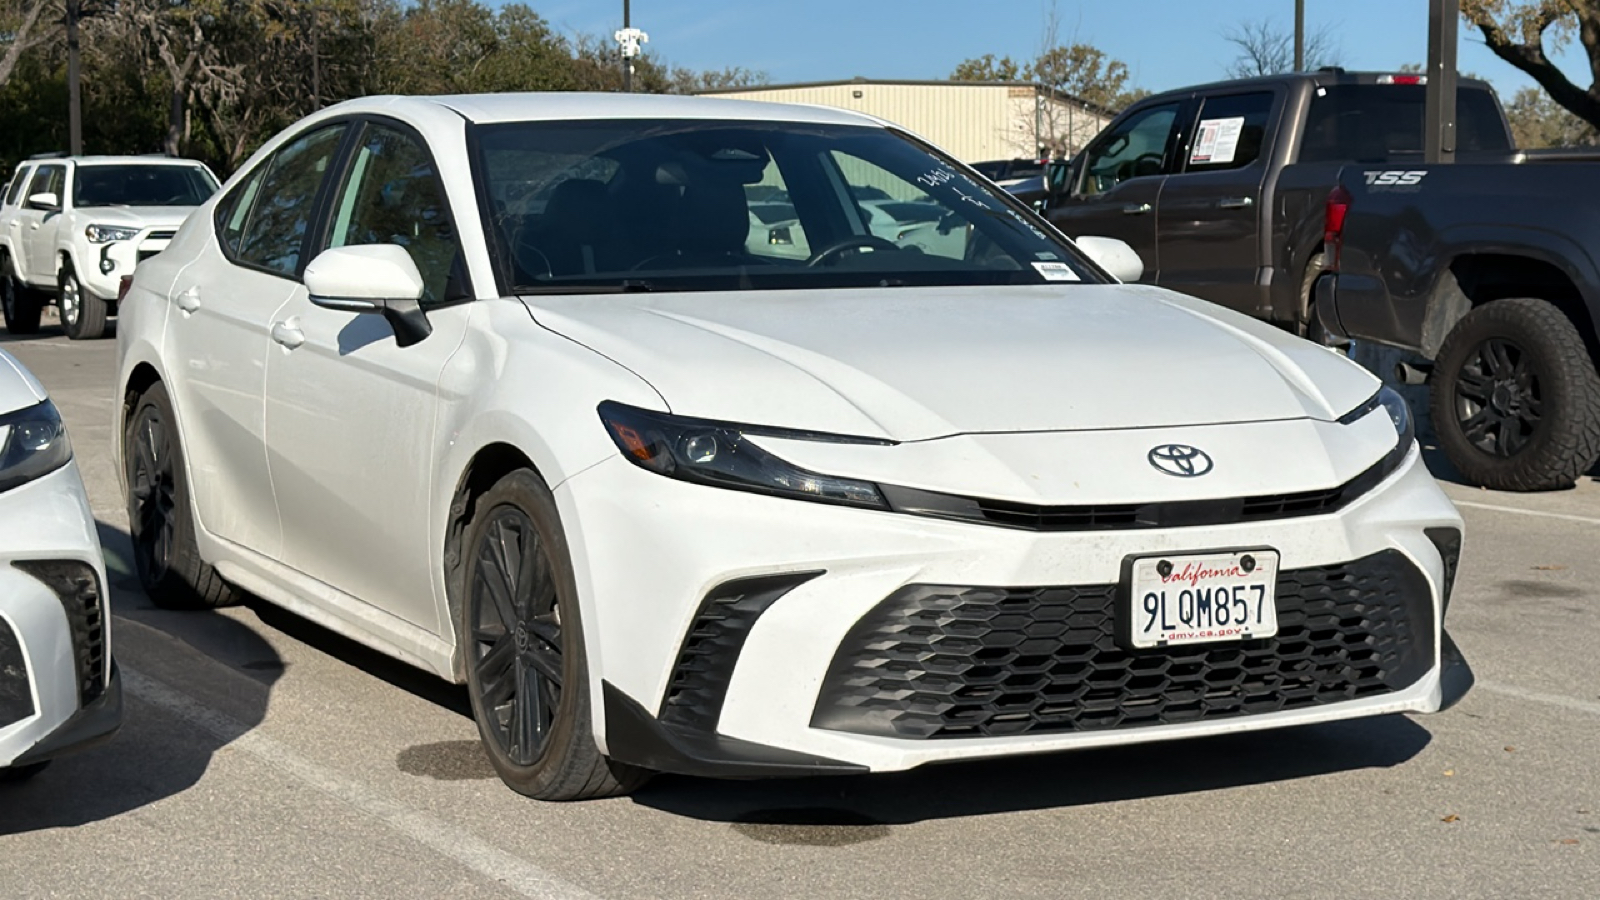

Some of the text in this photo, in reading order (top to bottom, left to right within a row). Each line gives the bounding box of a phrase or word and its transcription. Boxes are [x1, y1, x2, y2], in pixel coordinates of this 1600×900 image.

[1363, 171, 1428, 185] TSS
[1144, 585, 1265, 633] 9LQM857
[1169, 628, 1241, 640] dmv.ca.gov
